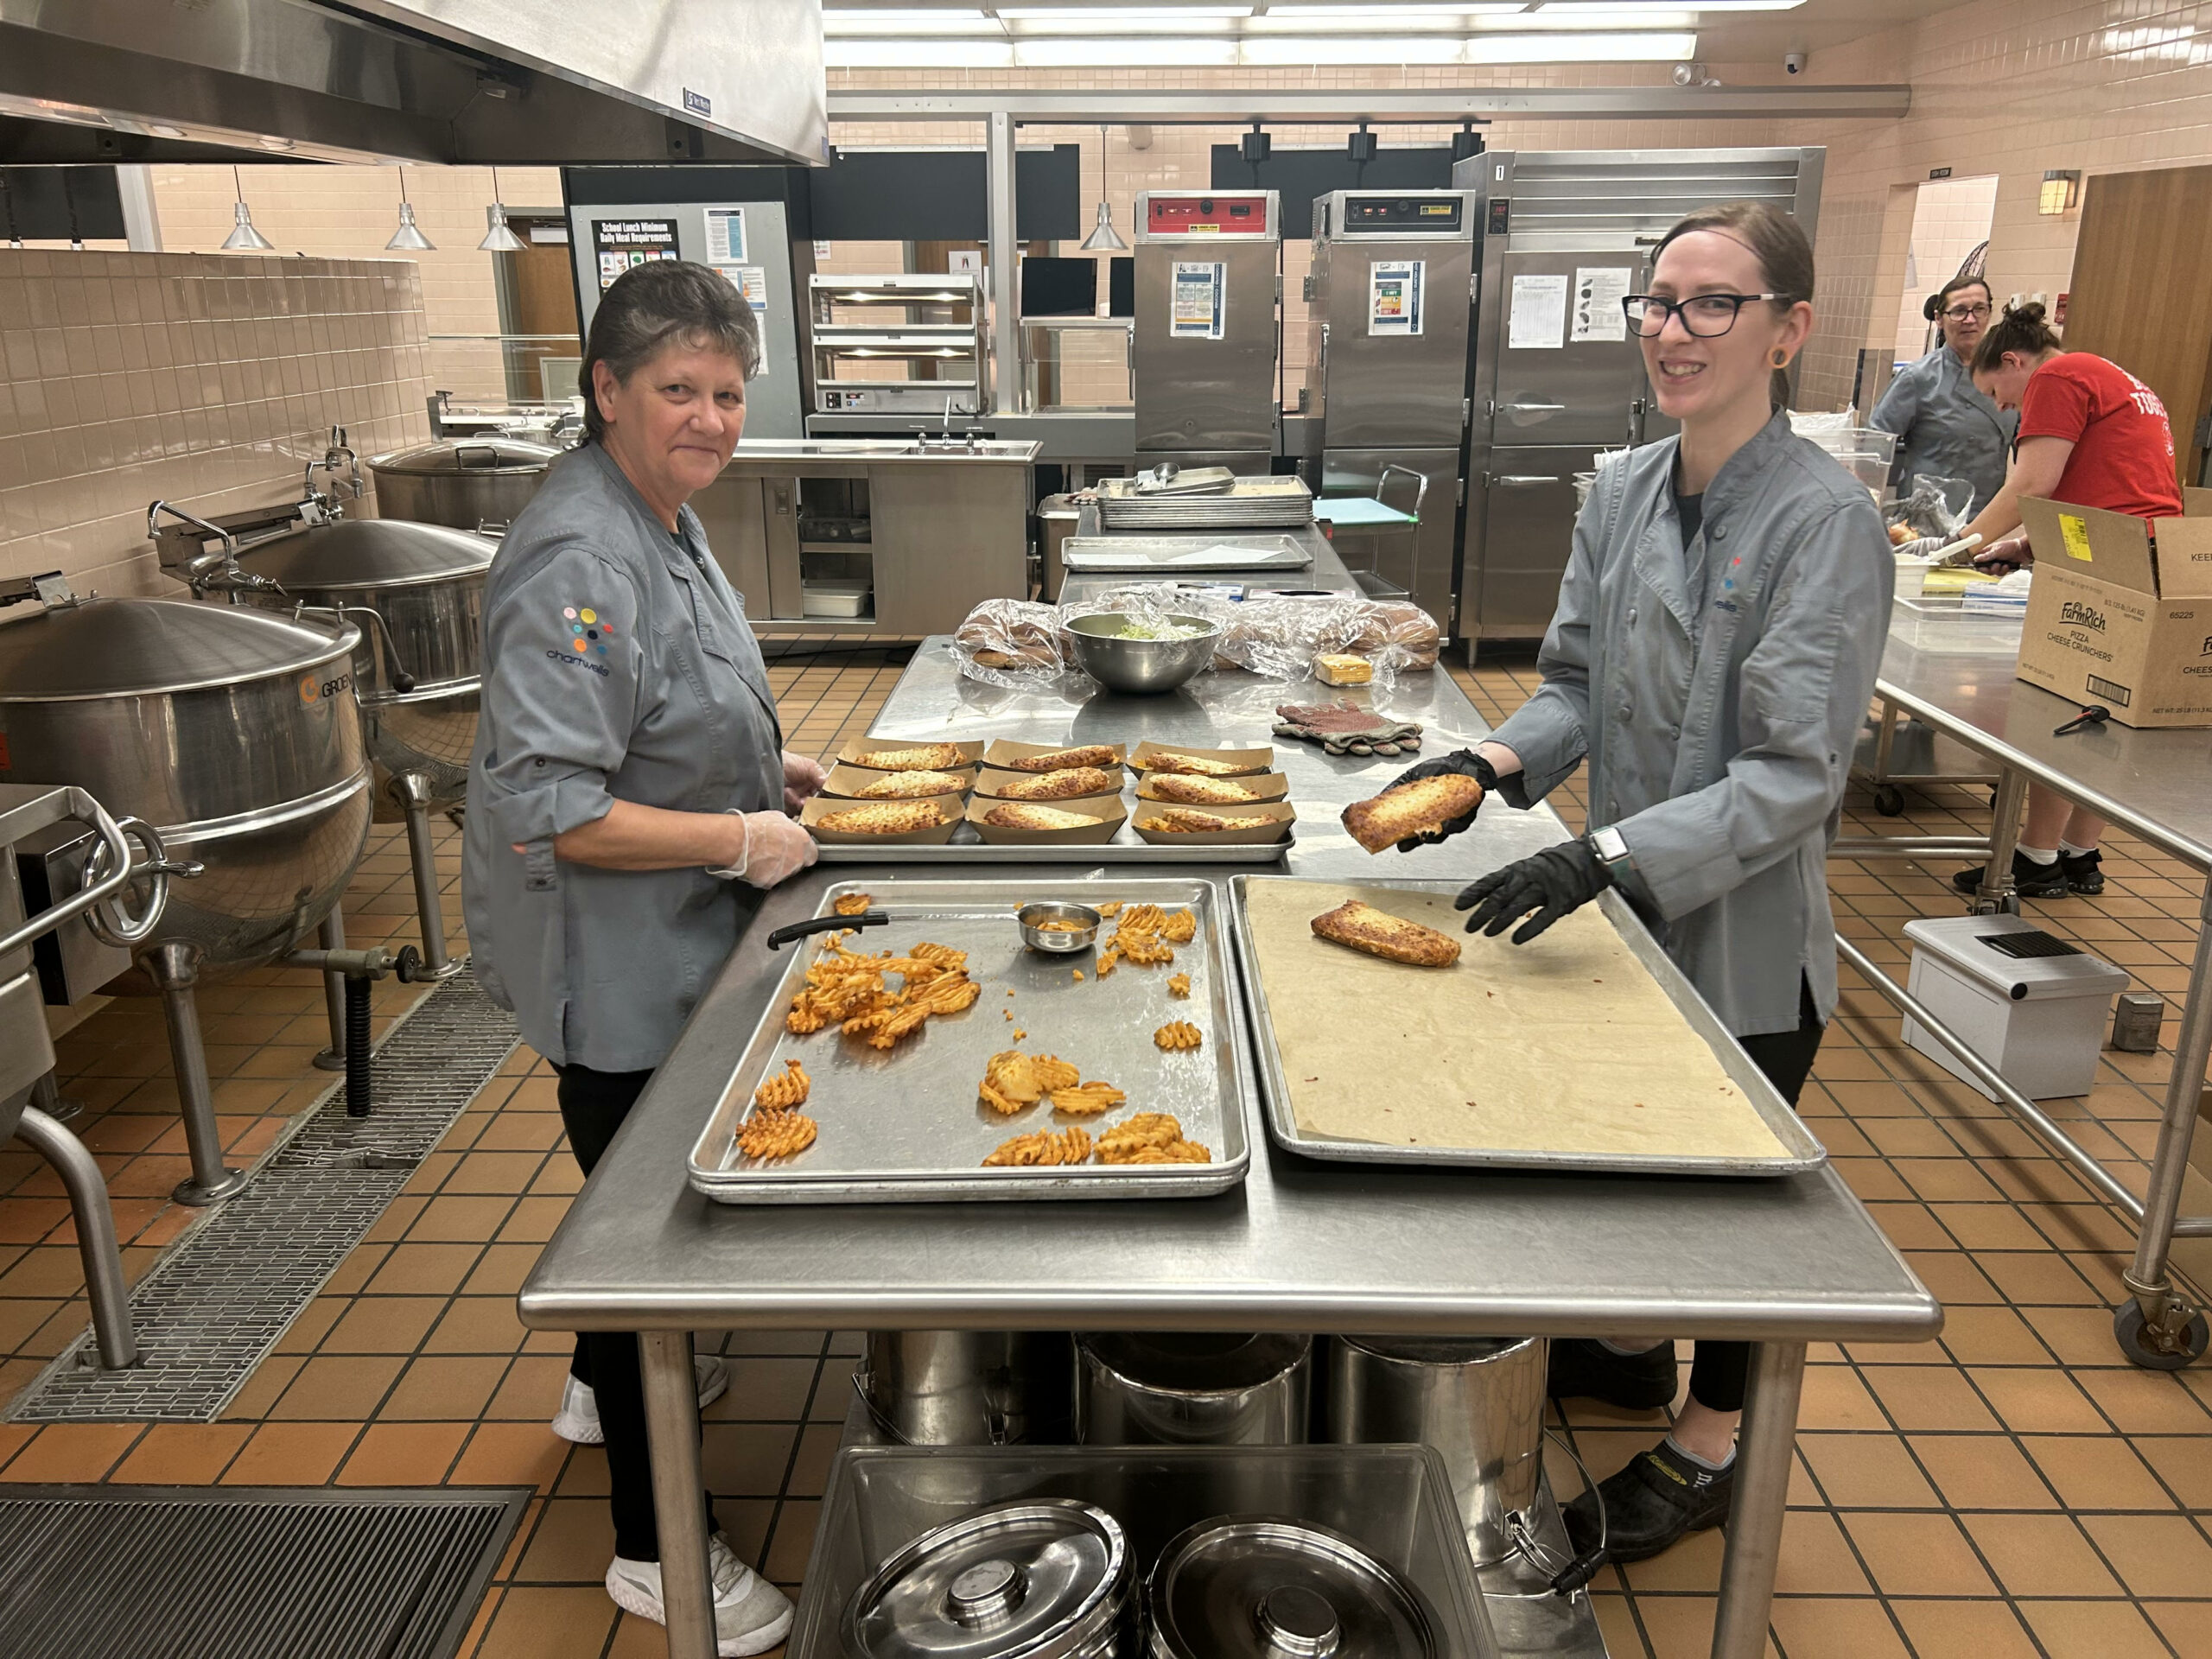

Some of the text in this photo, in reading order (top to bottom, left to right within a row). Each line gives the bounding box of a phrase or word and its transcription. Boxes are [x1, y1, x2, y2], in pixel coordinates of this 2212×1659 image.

[601, 222, 668, 232] School Lunch Minimum
[600, 232, 672, 244] Daily Meal Requirements
[2070, 630, 2089, 644] PIZZA
[2047, 632, 2113, 663] CHEESE CRUNCHERS
[546, 650, 609, 677] chartwells
[321, 671, 352, 698] GROEN
